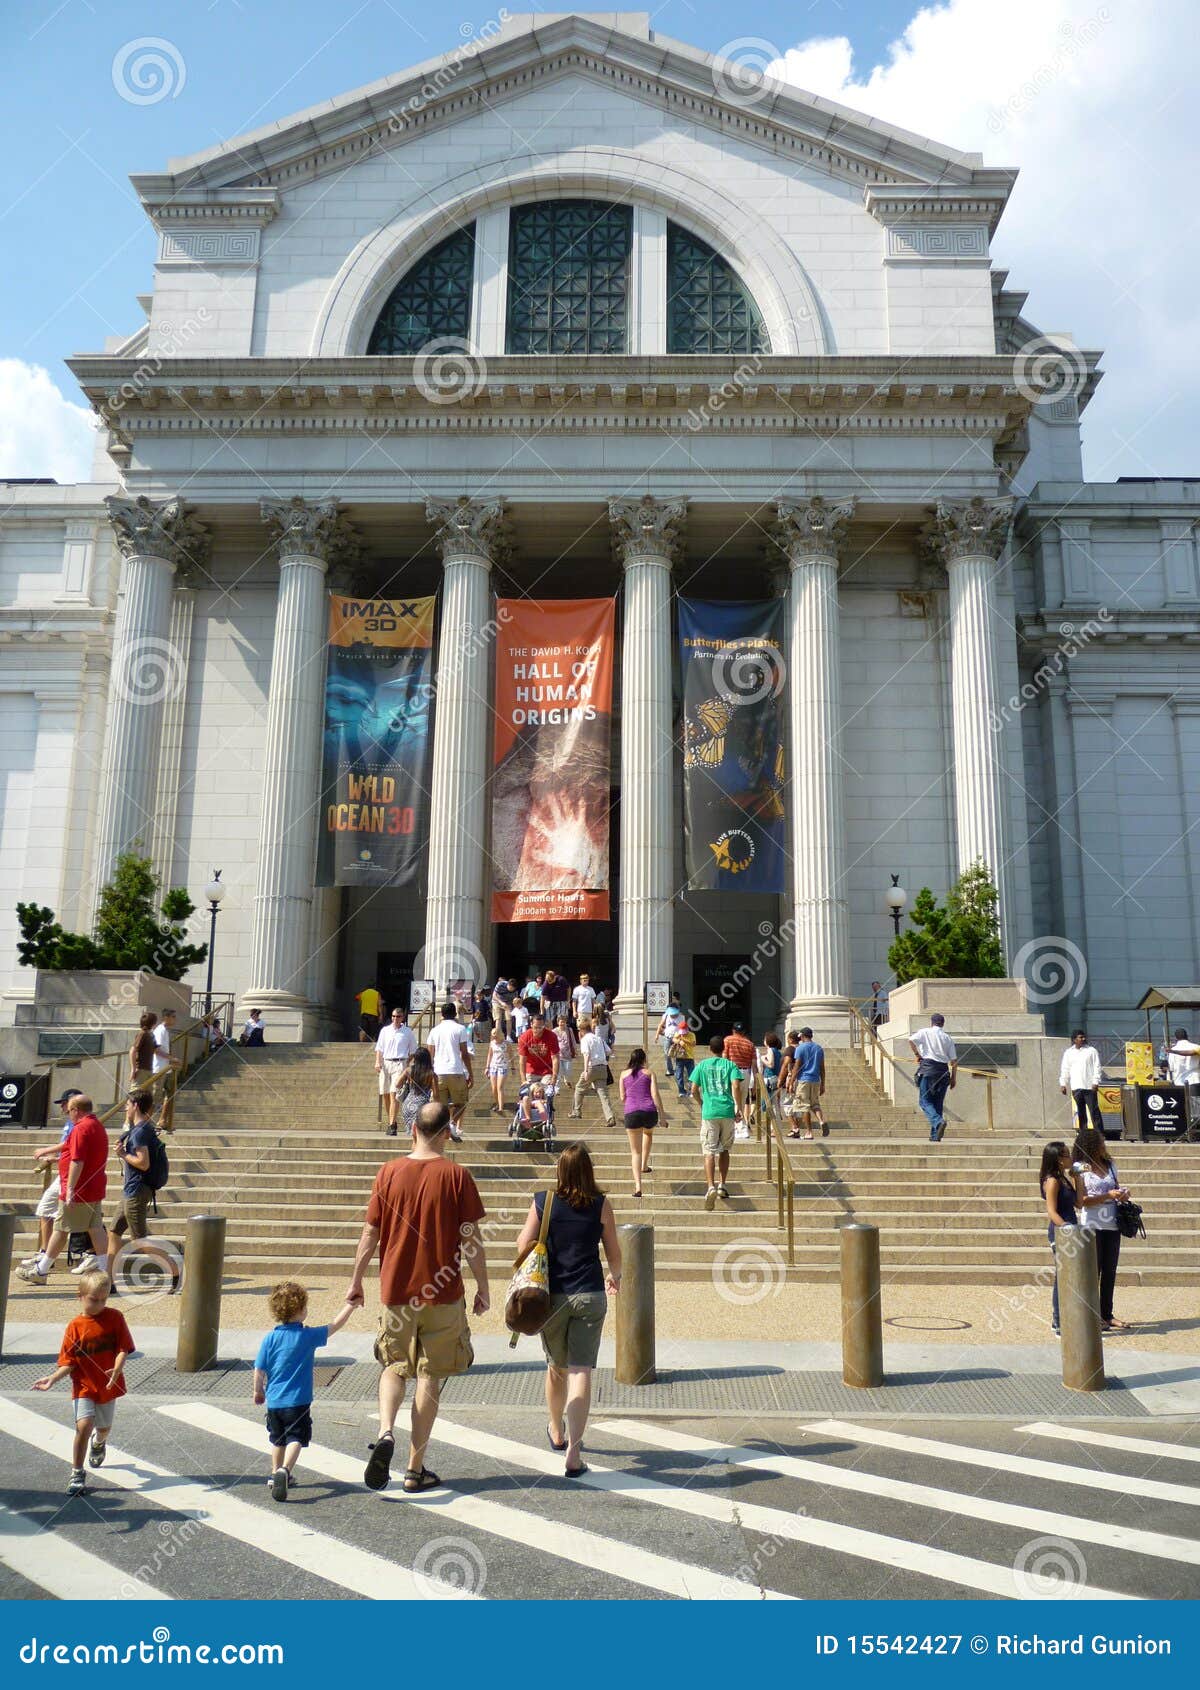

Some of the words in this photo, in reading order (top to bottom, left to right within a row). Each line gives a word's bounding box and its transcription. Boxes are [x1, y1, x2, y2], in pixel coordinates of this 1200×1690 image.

[342, 602, 418, 617] IMAX
[364, 619, 397, 631] 3D
[509, 647, 528, 657] THE
[531, 646, 560, 657] DAVID
[564, 645, 573, 655] H.
[683, 638, 738, 651] Butterflies
[747, 638, 781, 649] Plants
[513, 662, 563, 680] HALL
[571, 661, 596, 678] OF
[516, 684, 593, 702] HUMAN
[512, 704, 597, 726] ORIGINS
[348, 773, 396, 804] WILD
[327, 803, 385, 833] OCEAN
[386, 806, 415, 836] 3D
[716, 833, 728, 845] LIVE
[728, 829, 755, 857] BUTTERFLIES
[518, 893, 555, 903] Summer
[557, 892, 585, 903] Hours
[549, 907, 557, 915] to
